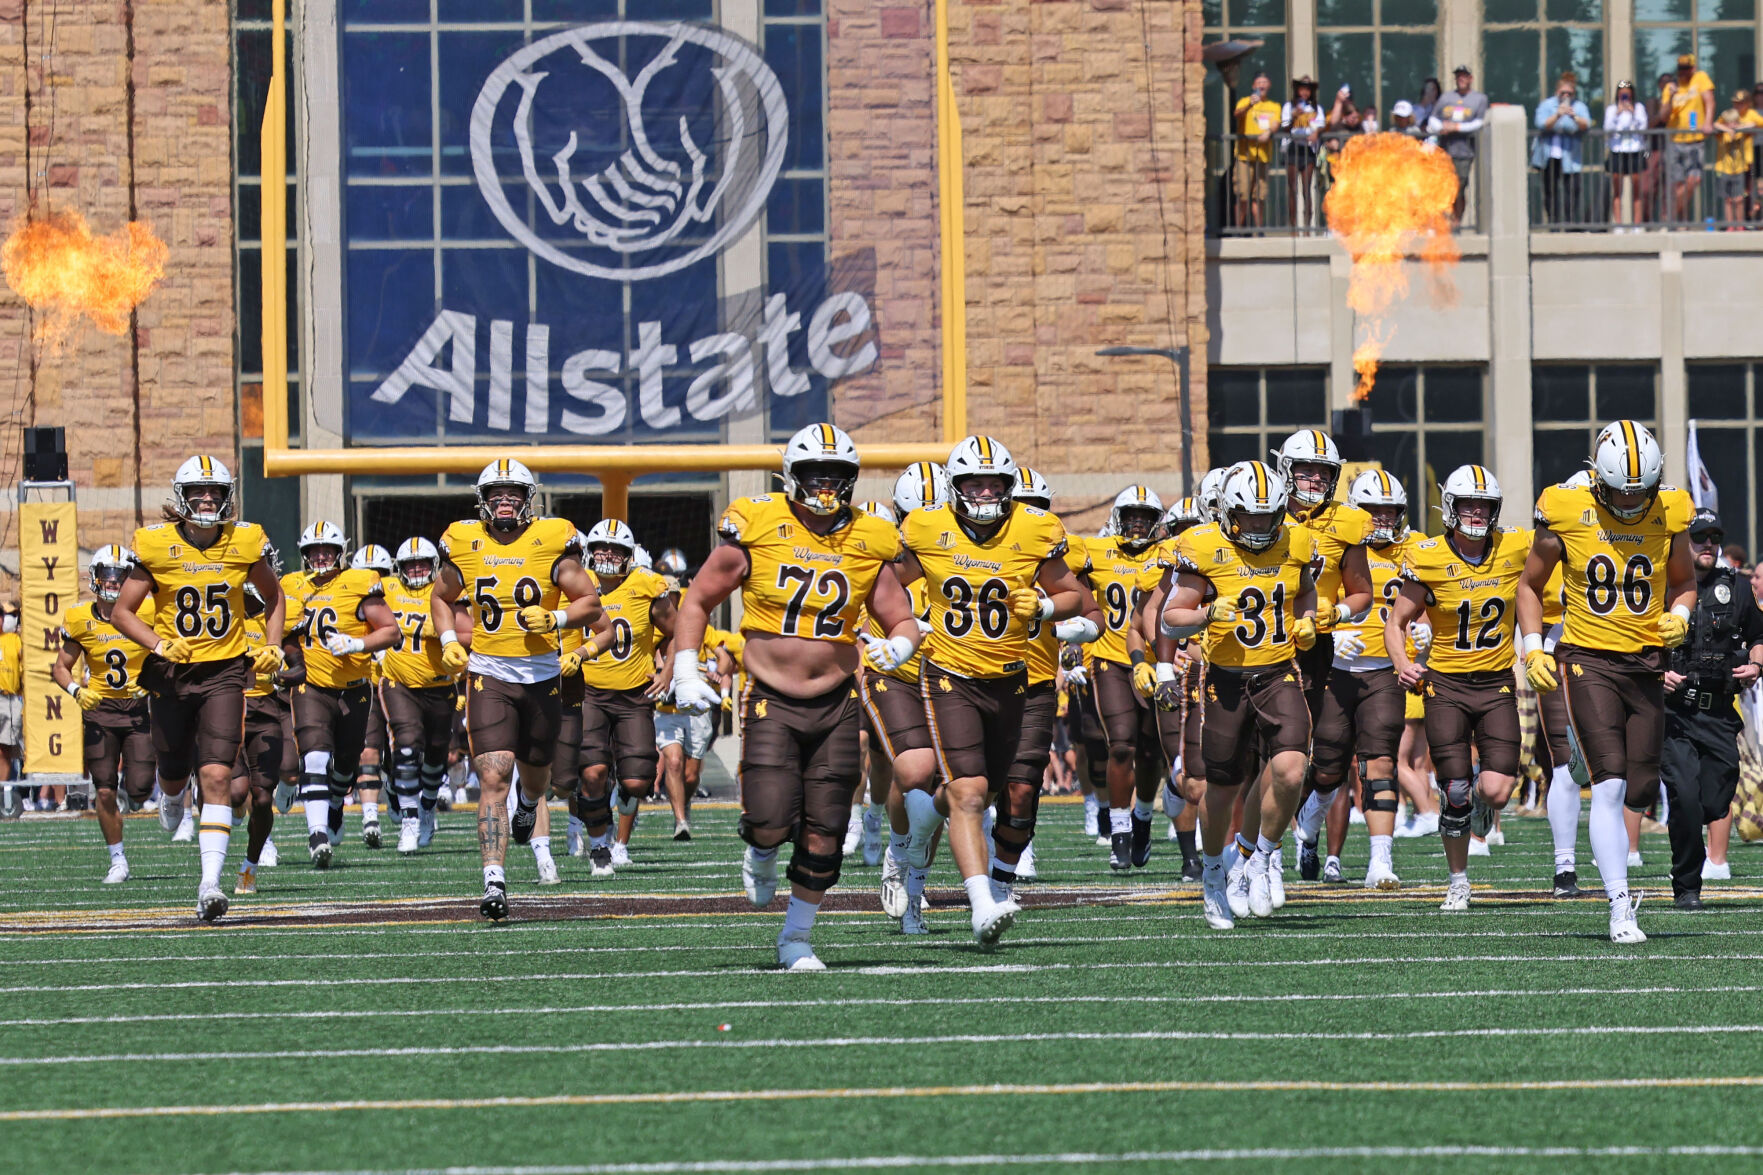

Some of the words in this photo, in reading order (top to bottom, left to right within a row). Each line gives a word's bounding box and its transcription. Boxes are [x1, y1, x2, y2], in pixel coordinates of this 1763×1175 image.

[369, 291, 879, 436] Allstate
[1597, 529, 1645, 546] Wyoming
[483, 555, 526, 567] Wyoming
[793, 546, 843, 566] Wyoming
[953, 553, 1003, 574] Wyoming
[1367, 559, 1397, 571] yoming
[182, 562, 224, 574] Wyoming
[1113, 565, 1138, 576] Wyom
[1237, 565, 1281, 579] Wyoming
[1459, 576, 1500, 592] Wyoming
[1584, 553, 1654, 617] 86
[174, 580, 233, 641] 85
[775, 563, 850, 640] 72
[942, 575, 1010, 640] 36
[1234, 581, 1288, 649] 31
[1454, 596, 1507, 651] 12
[105, 648, 129, 690] 3
